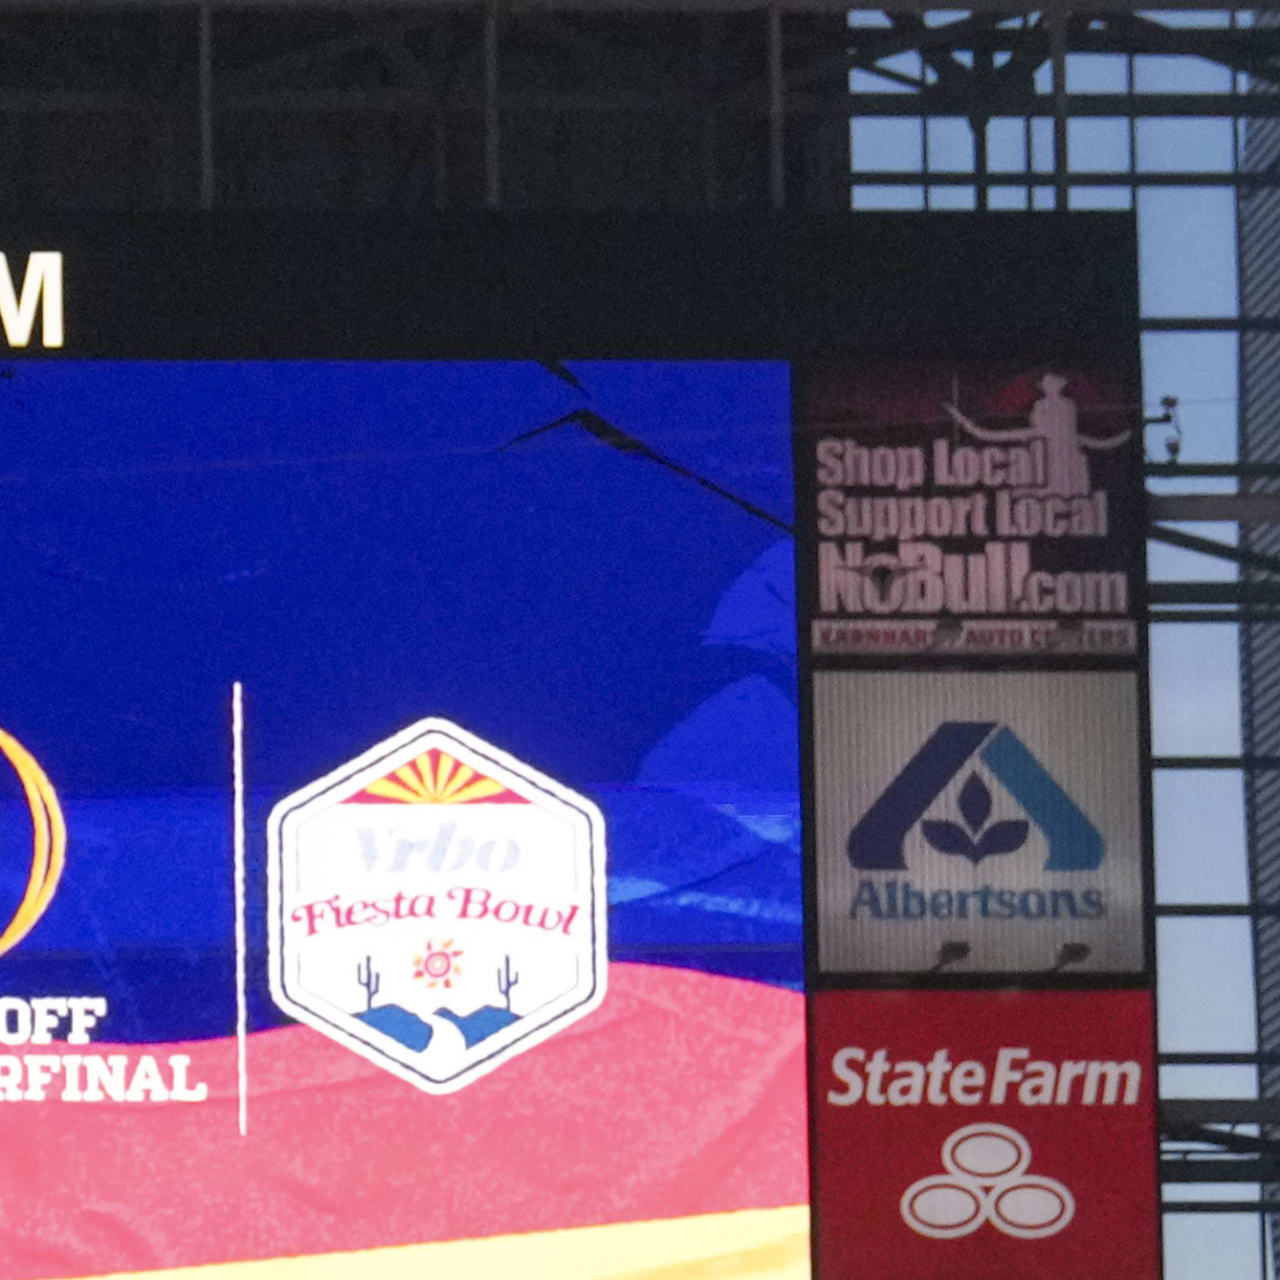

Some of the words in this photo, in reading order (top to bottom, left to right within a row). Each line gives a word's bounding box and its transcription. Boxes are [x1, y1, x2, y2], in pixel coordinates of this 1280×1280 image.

[816, 438, 926, 491] Shop
[933, 437, 1048, 489] Local
[816, 490, 988, 540] Support
[995, 488, 1108, 537] Local
[356, 820, 521, 873] Vrbo
[291, 891, 436, 936] Fiesta
[446, 886, 580, 936] Bowl
[848, 883, 1105, 921] Albertsons
